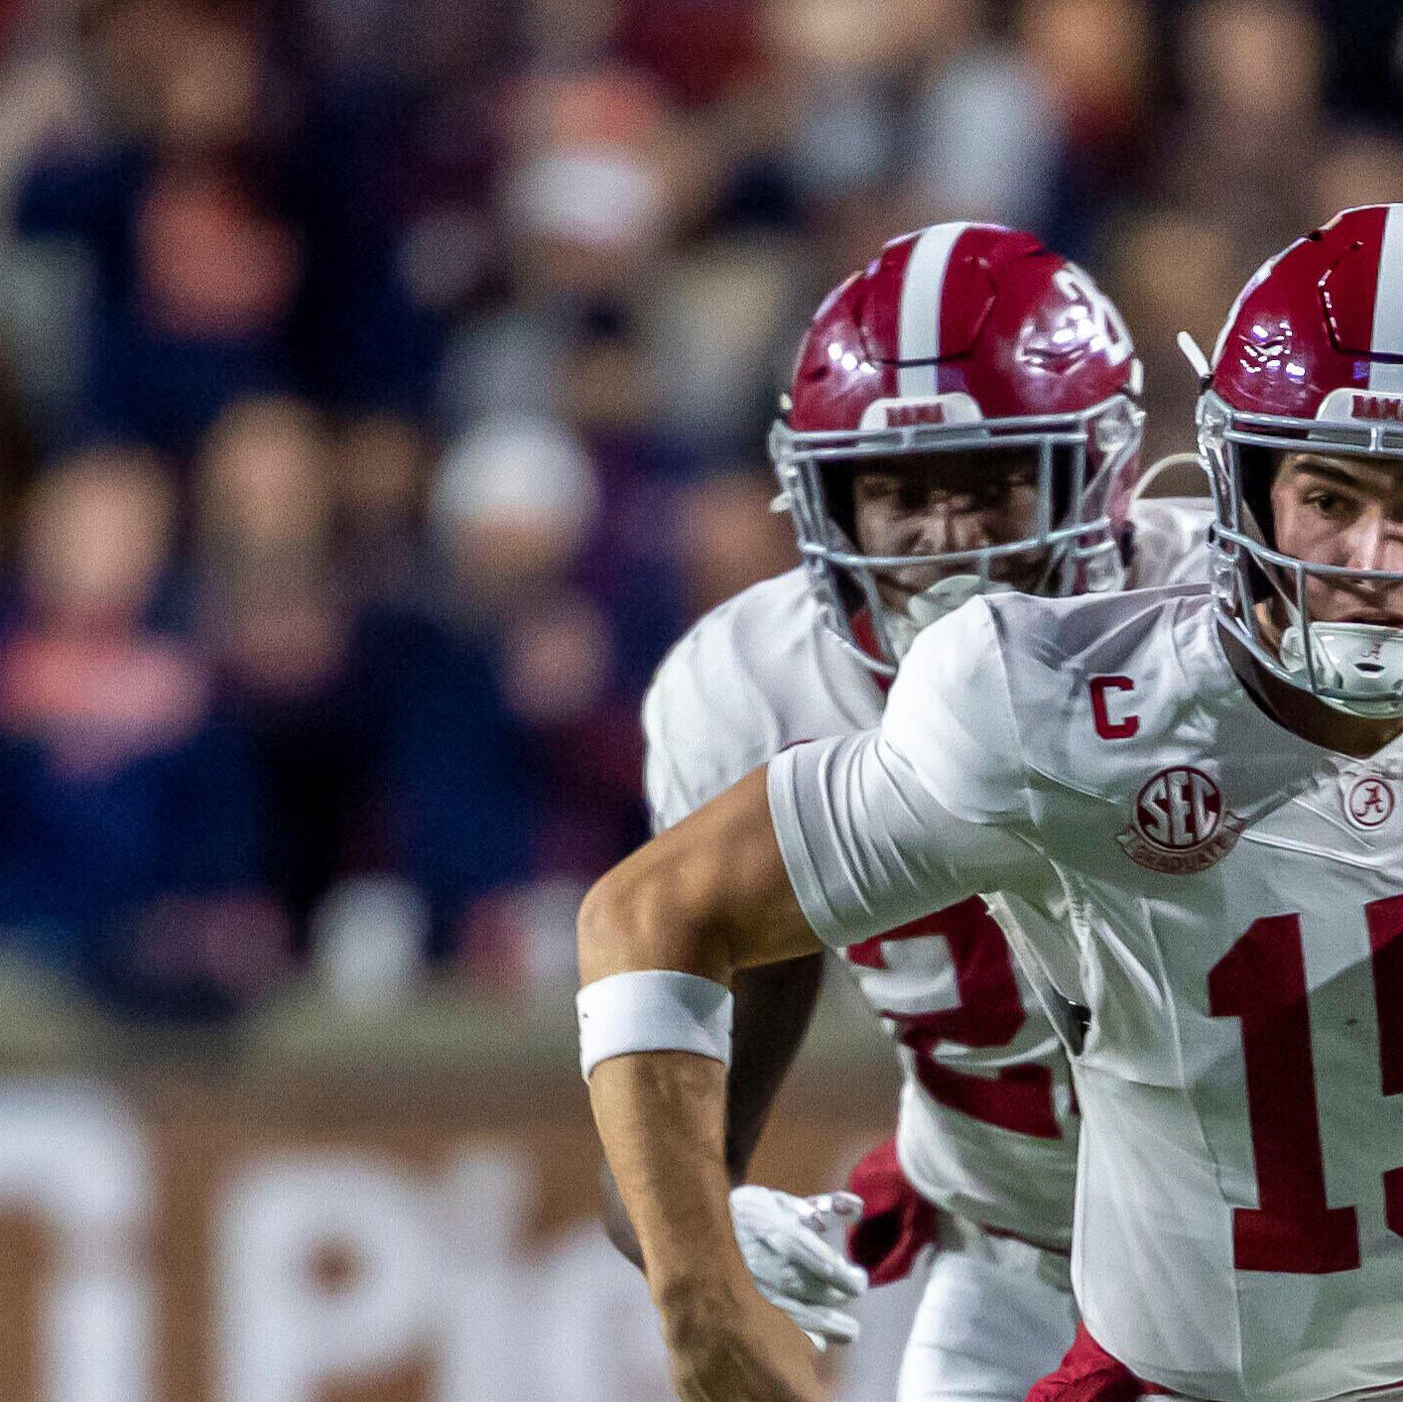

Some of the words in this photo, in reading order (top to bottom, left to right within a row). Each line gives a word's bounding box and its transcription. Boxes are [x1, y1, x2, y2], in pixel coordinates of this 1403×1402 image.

[1090, 675, 1140, 740] C
[1140, 770, 1218, 845] SEC
[847, 893, 1082, 1140] 2
